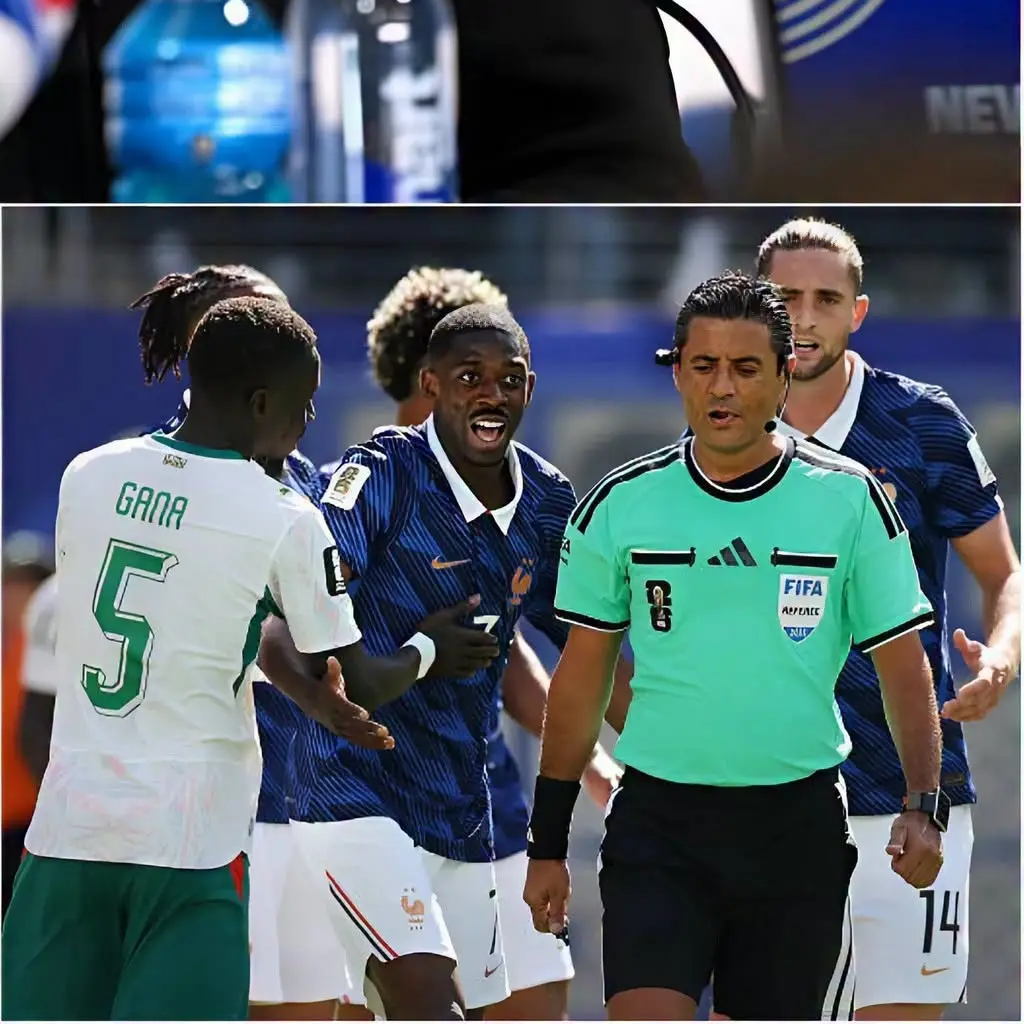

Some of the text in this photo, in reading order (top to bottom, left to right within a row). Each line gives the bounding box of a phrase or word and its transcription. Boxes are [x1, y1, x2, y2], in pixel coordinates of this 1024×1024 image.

[115, 481, 188, 530] GANA
[783, 578, 823, 596] FIFA
[80, 538, 179, 718] 5
[919, 889, 960, 955] 14
